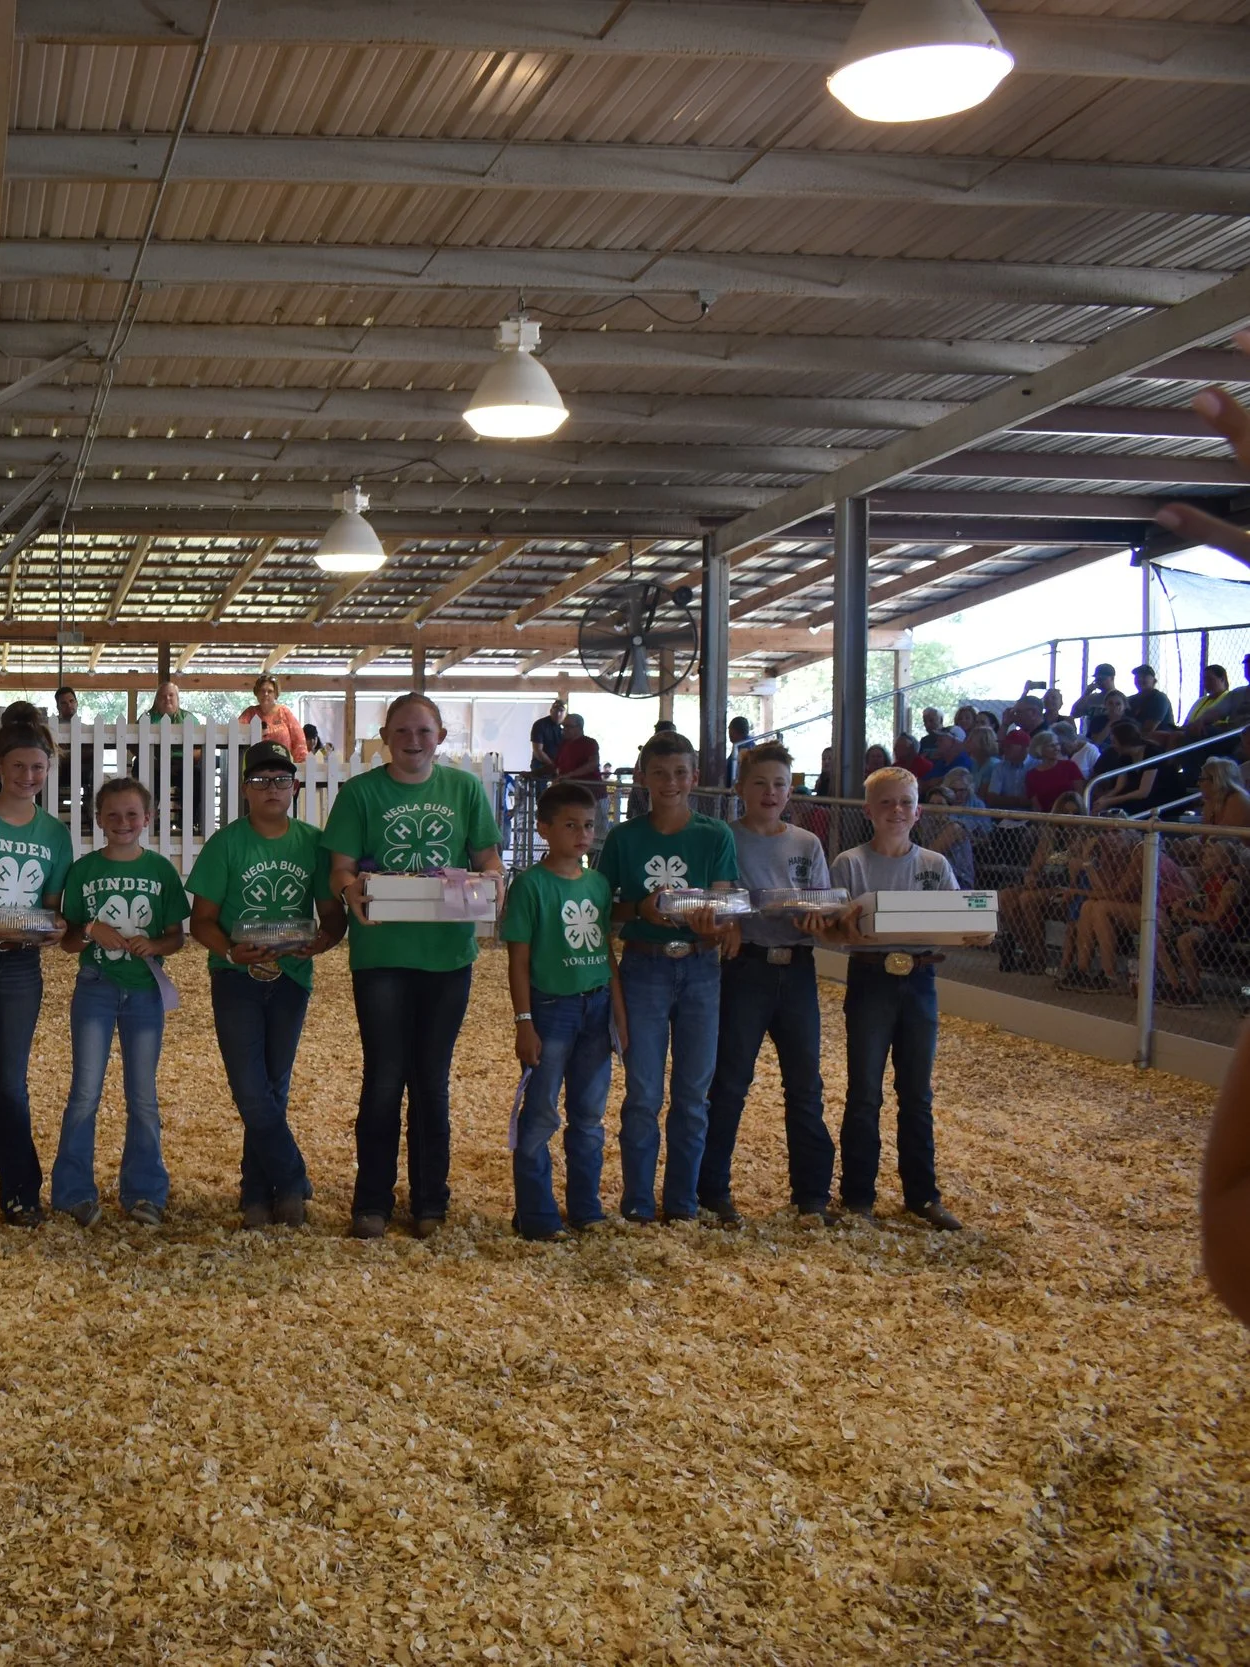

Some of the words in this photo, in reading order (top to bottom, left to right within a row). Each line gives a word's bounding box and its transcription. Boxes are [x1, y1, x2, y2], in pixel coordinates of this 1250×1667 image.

[382, 803, 421, 822] NEOLA
[423, 803, 455, 818] BUSY
[241, 860, 278, 882] NEOLA
[279, 860, 309, 881] BUSY
[82, 877, 162, 897] MINDEN
